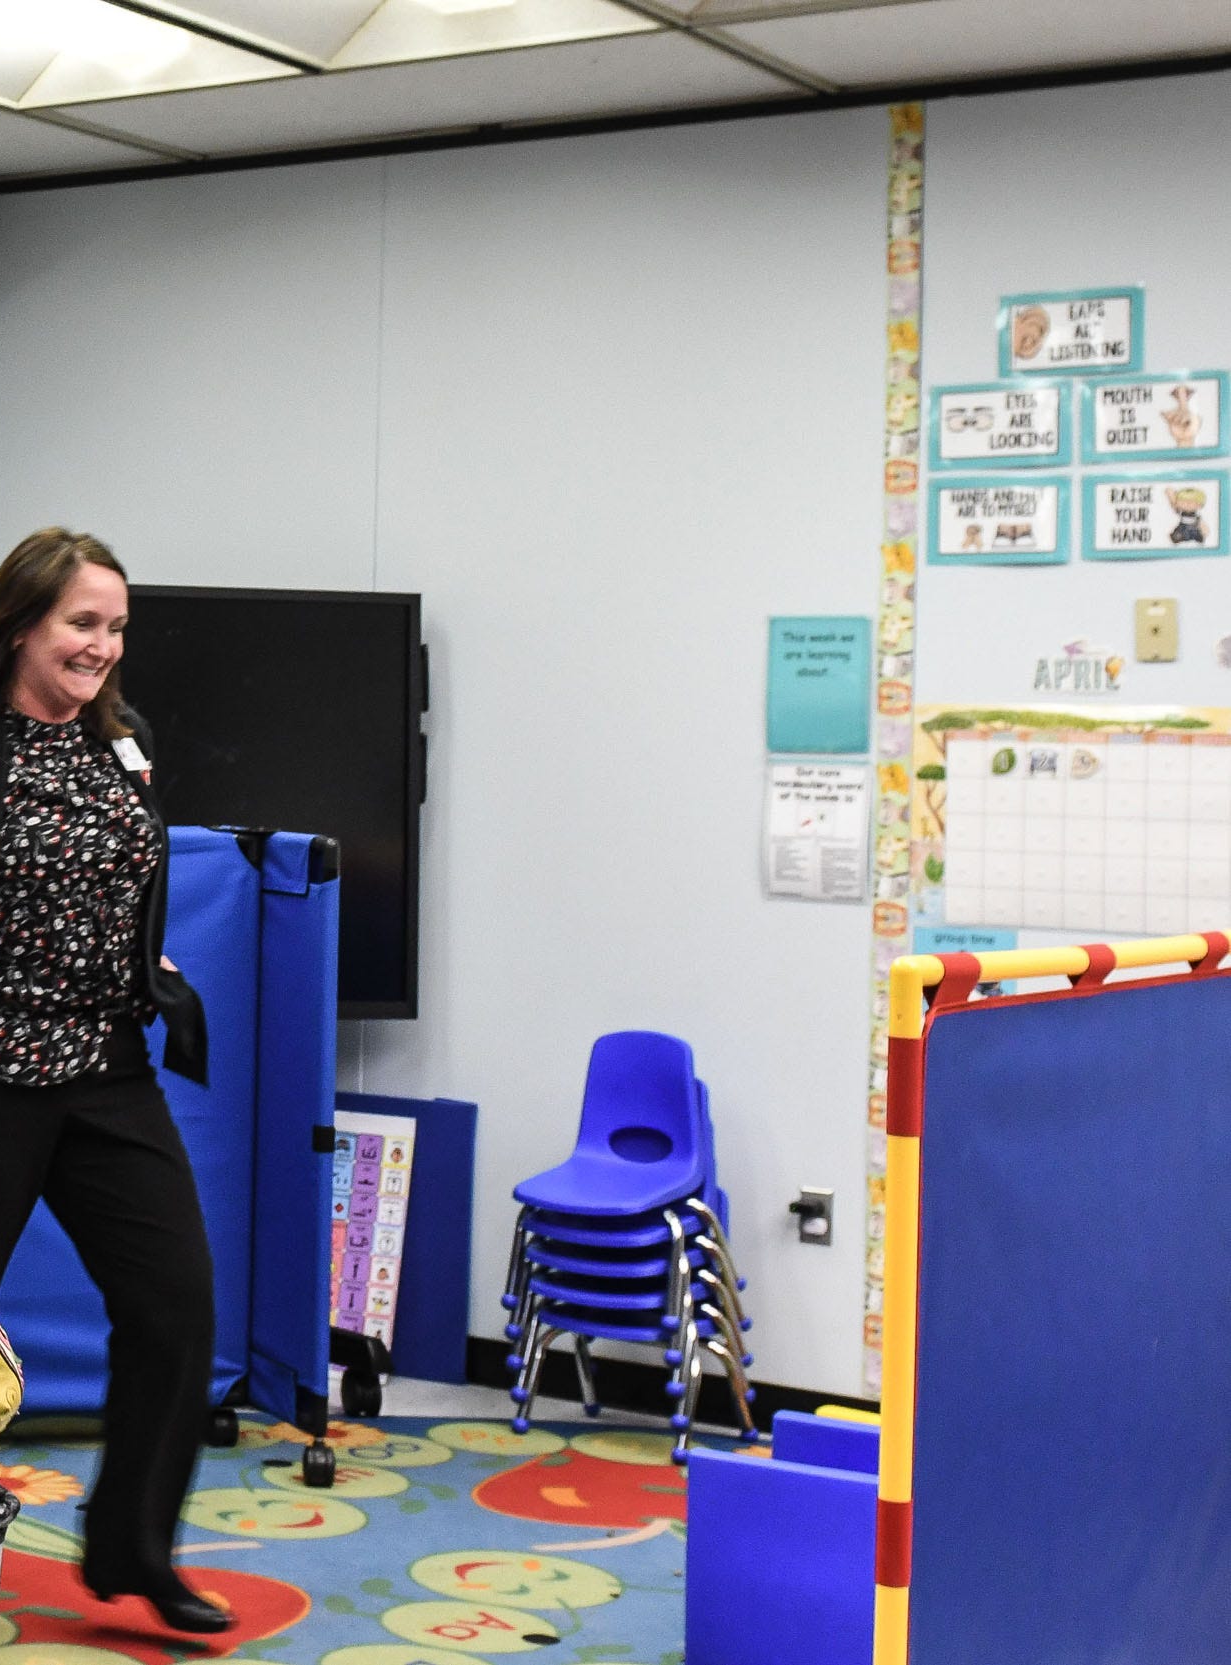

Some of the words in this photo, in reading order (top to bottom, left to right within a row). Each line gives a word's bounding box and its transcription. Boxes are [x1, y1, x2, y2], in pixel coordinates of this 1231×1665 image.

[1006, 393, 1037, 409] EYES
[1103, 388, 1152, 406] MOUTH
[1009, 413, 1033, 429] ARE
[1120, 409, 1136, 424] IS
[989, 431, 1054, 449] LOOKING
[1106, 427, 1148, 445] QUIET
[1110, 487, 1152, 504] RAISE
[1114, 507, 1149, 523] YOUR
[1111, 527, 1152, 544] HAND
[425, 1611, 516, 1641] Aa
